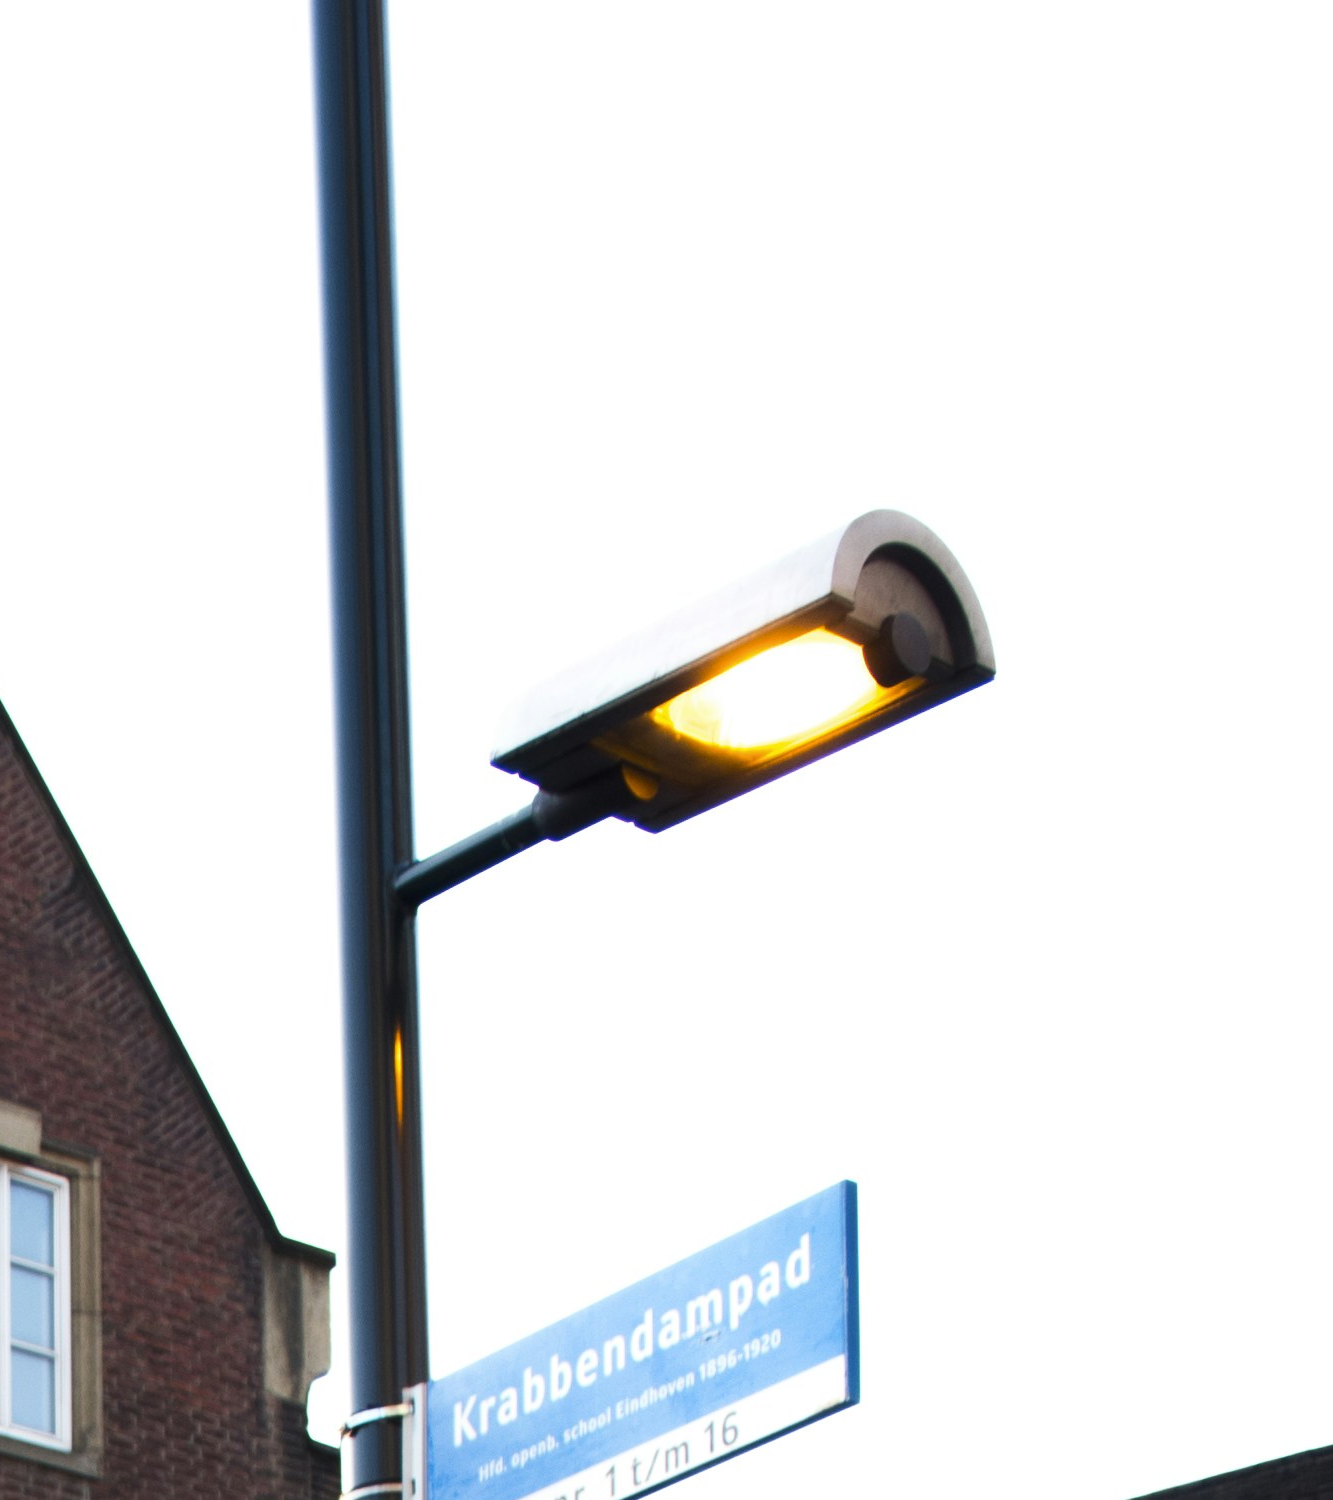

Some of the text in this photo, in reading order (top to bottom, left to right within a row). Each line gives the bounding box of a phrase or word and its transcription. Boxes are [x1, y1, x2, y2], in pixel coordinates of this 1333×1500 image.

[452, 1231, 811, 1448] Krabbendampad
[478, 1328, 782, 1482] Hfd. openb. school Eindhoven 1896-1920
[605, 1465, 617, 1497] 1
[630, 1441, 690, 1488] t/m
[703, 1411, 740, 1453] 16
